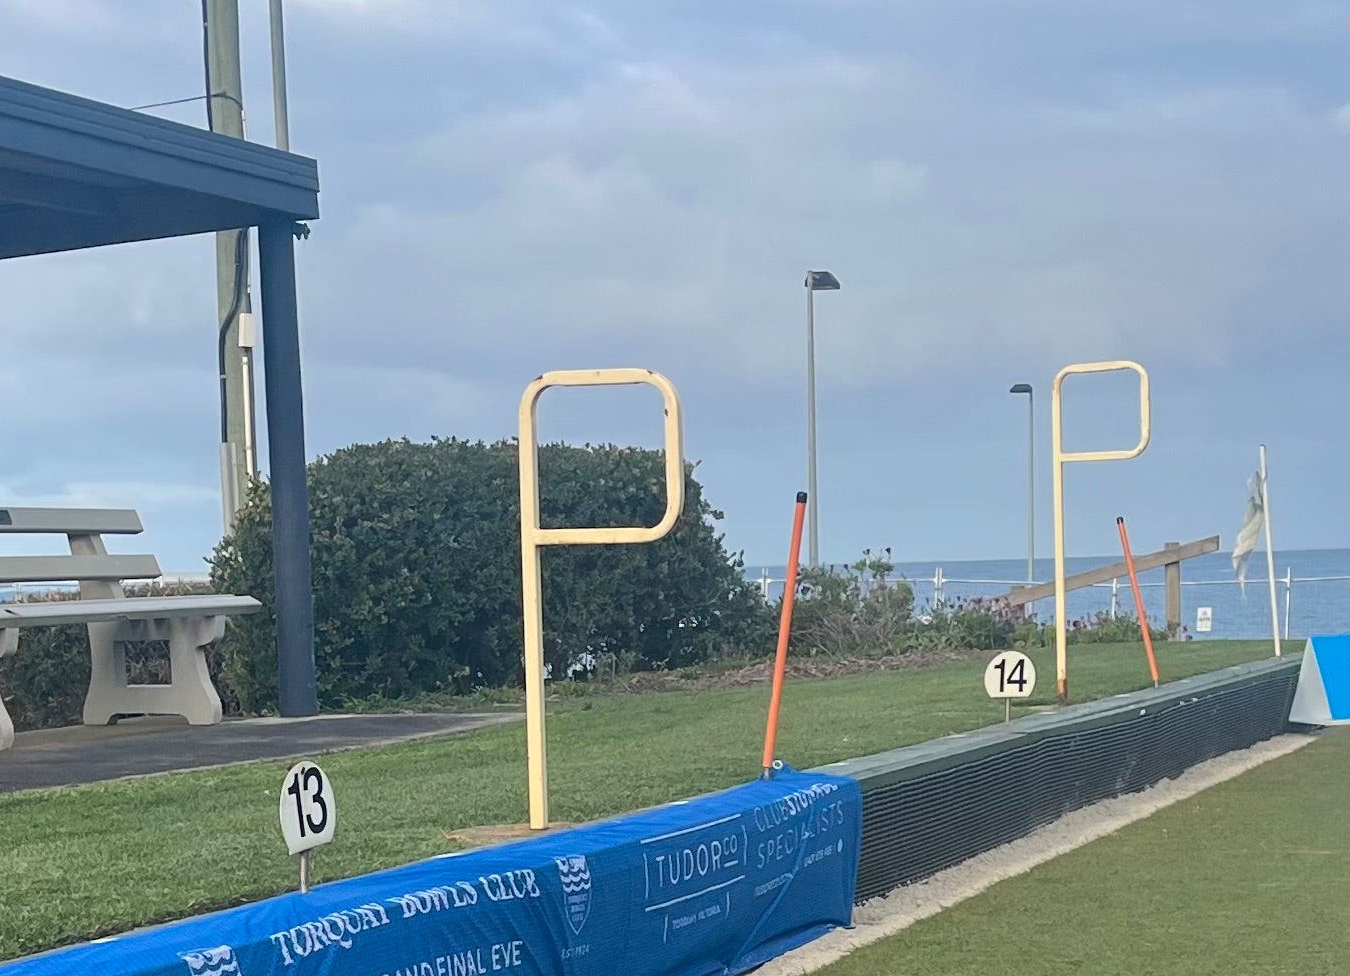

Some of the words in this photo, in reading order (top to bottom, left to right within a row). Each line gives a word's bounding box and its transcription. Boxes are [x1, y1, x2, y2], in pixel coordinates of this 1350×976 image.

[994, 658, 1027, 693] 14
[288, 767, 327, 838] 13
[269, 903, 392, 966] TORQUAY
[479, 869, 541, 901] CLUB
[491, 941, 524, 970] EVE
